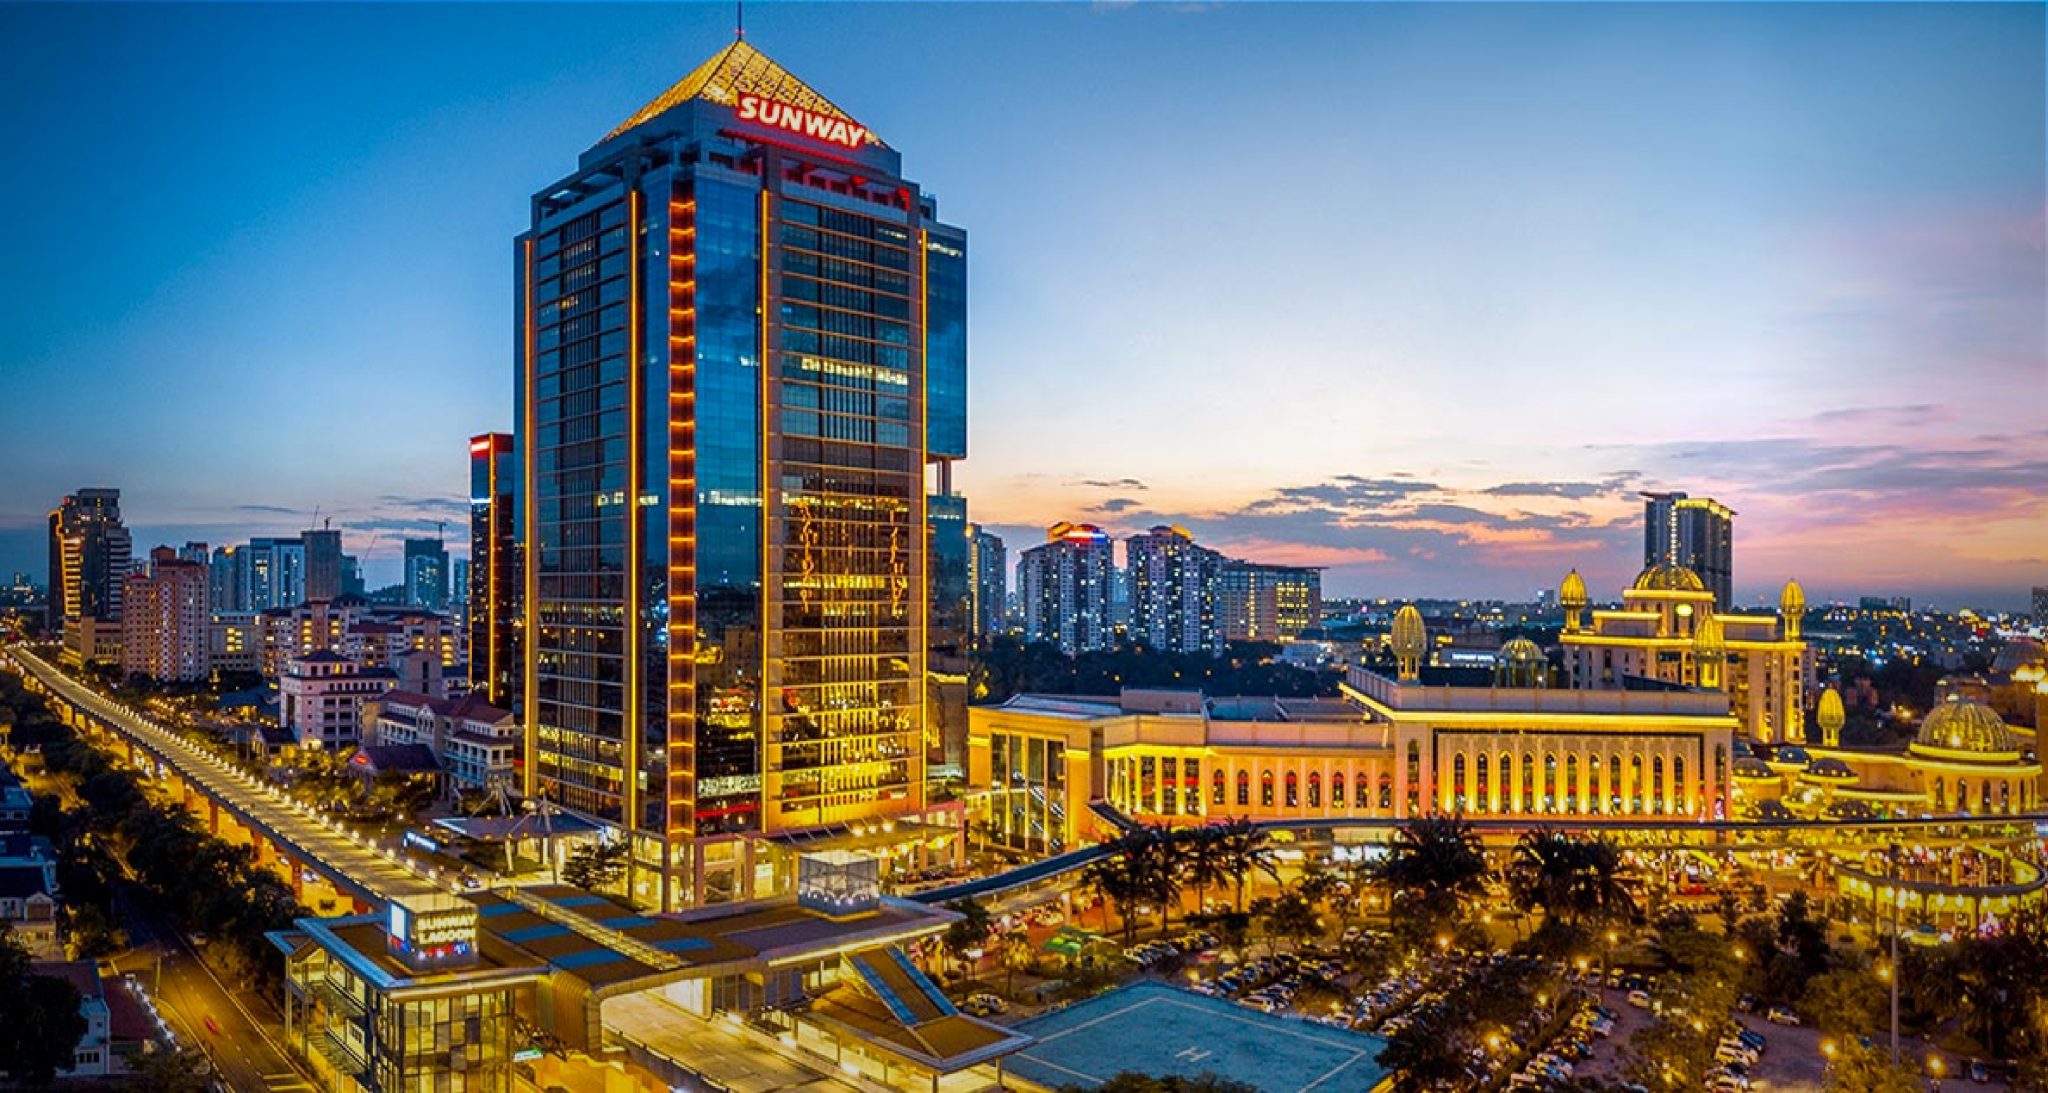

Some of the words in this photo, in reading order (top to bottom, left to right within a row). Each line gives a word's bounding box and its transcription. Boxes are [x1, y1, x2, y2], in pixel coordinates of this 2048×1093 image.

[739, 96, 865, 147] SUNWAY
[417, 913, 477, 931] SUNWAY
[1175, 1046, 1212, 1063] H
